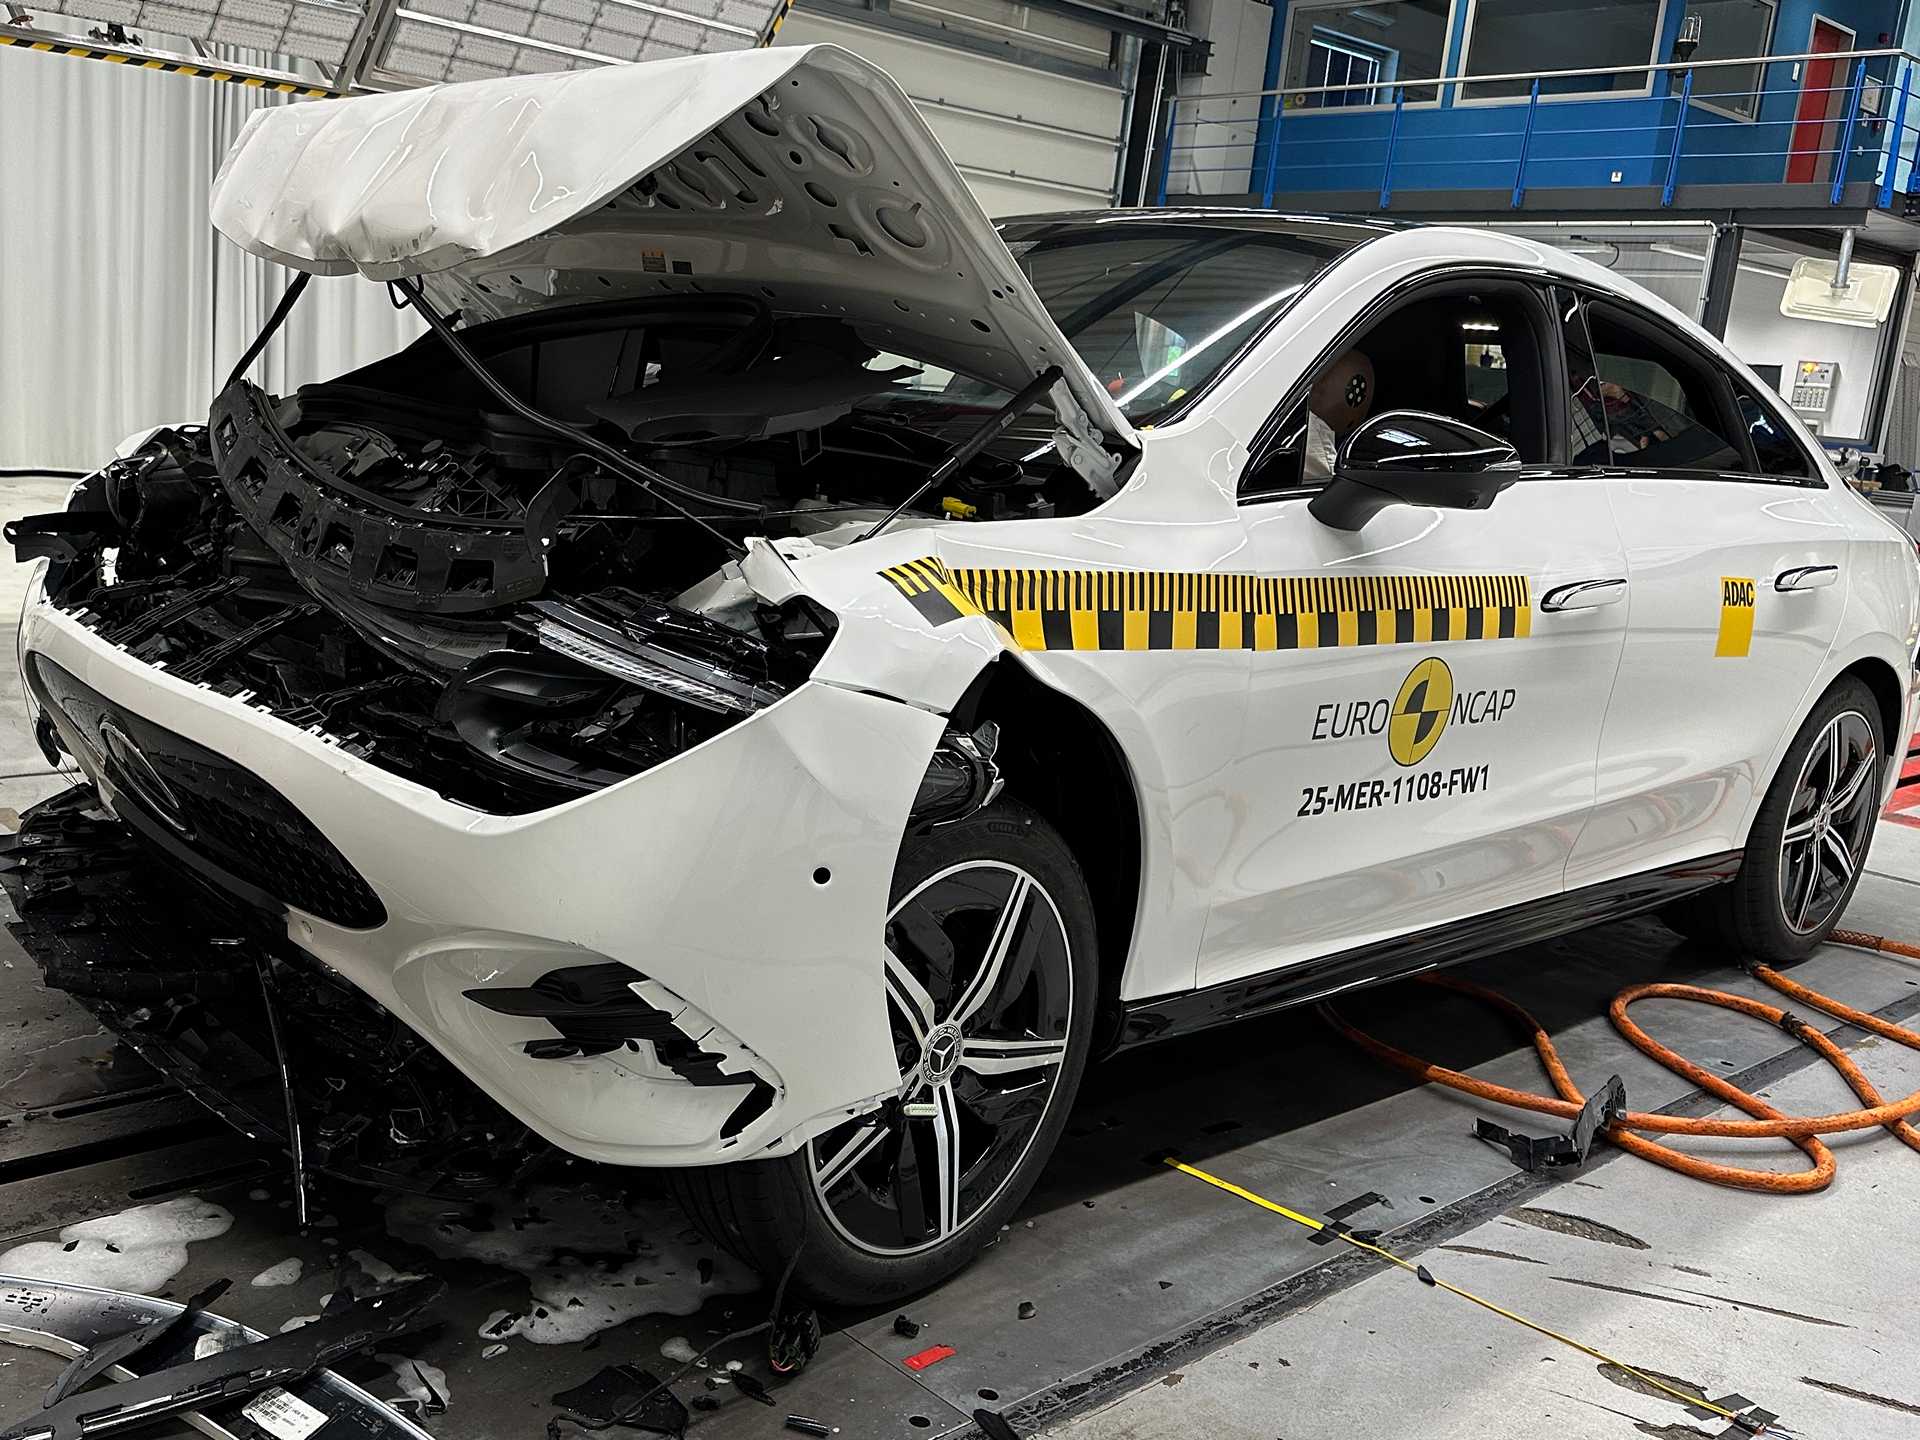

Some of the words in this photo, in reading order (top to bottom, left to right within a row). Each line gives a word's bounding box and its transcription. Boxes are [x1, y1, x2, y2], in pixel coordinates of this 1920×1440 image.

[1723, 581, 1754, 607] ADAC
[1313, 699, 1389, 739] EURO
[1451, 690, 1516, 725] NCAP
[1298, 765, 1489, 816] 25-MER-1108-FW1
